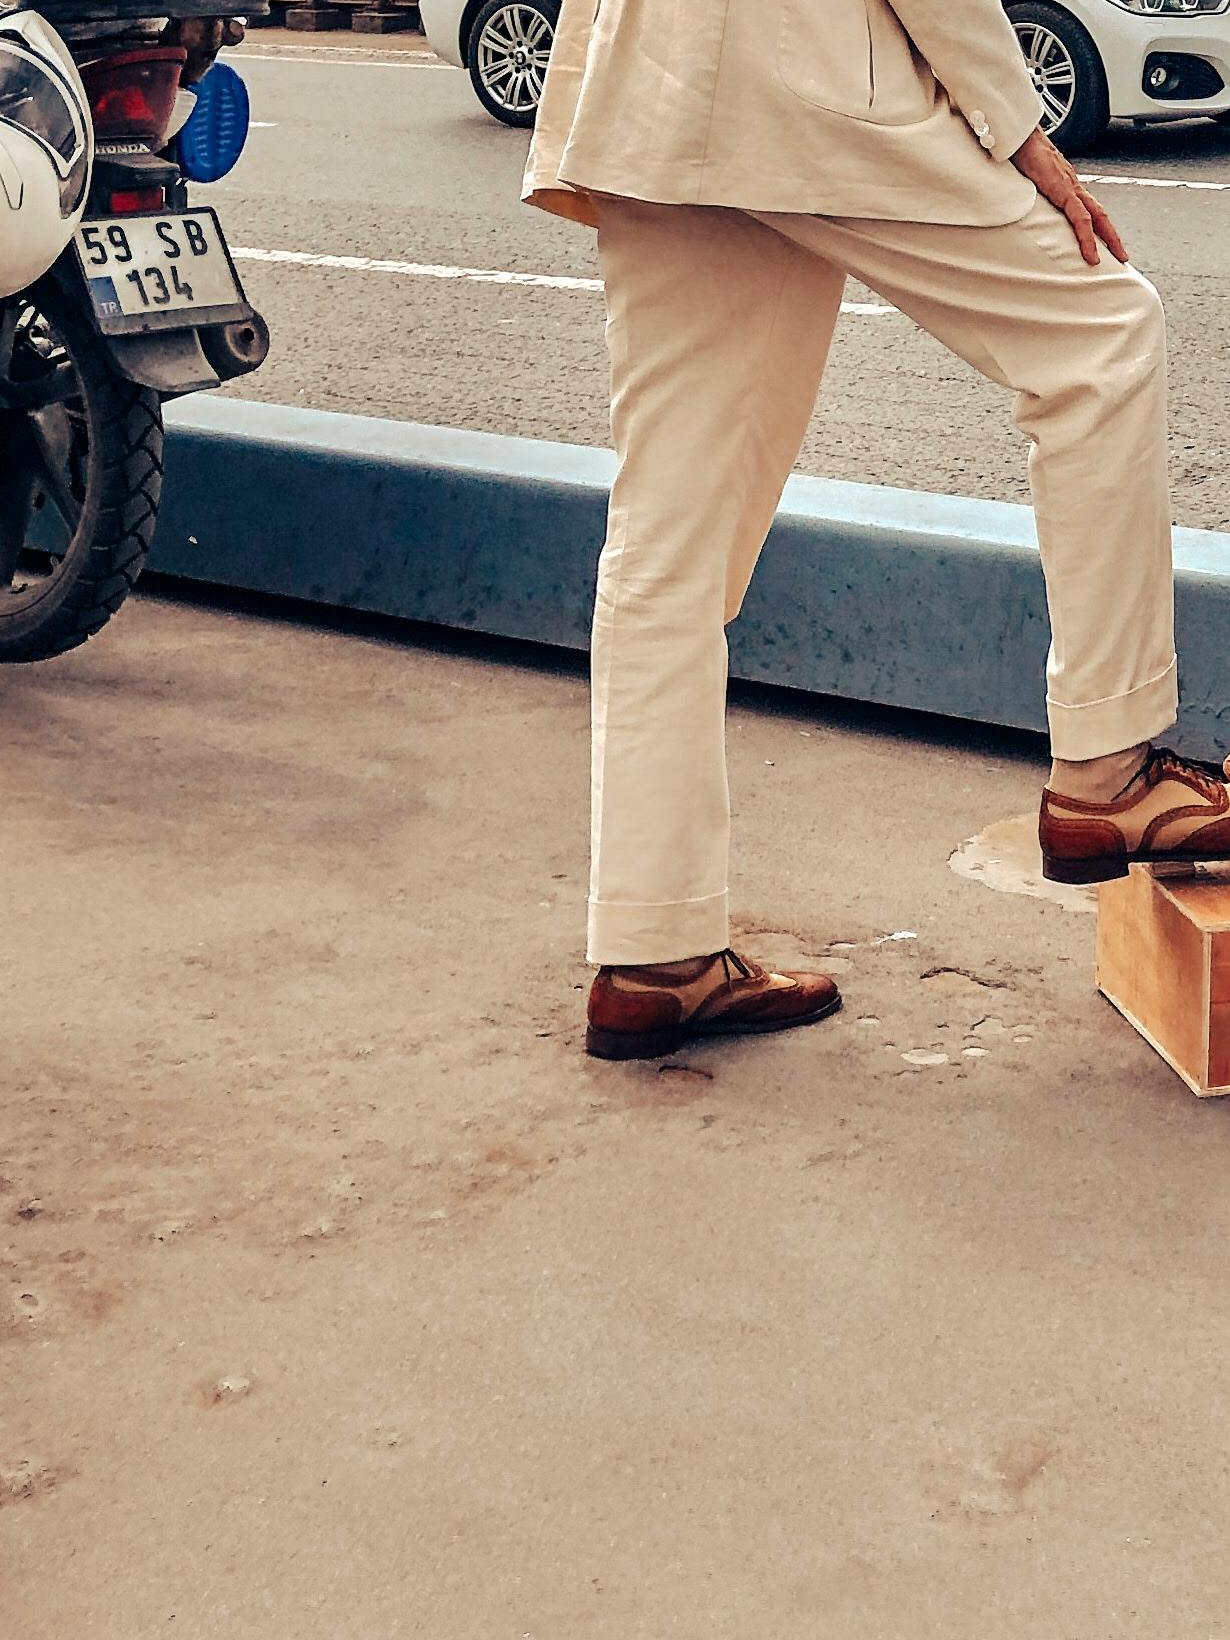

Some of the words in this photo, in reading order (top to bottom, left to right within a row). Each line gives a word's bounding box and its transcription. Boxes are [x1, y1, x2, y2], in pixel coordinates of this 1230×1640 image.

[95, 144, 151, 154] HONDA
[80, 225, 133, 265] 59
[155, 219, 208, 259] SB
[125, 265, 194, 306] 134
[100, 301, 118, 314] TR
